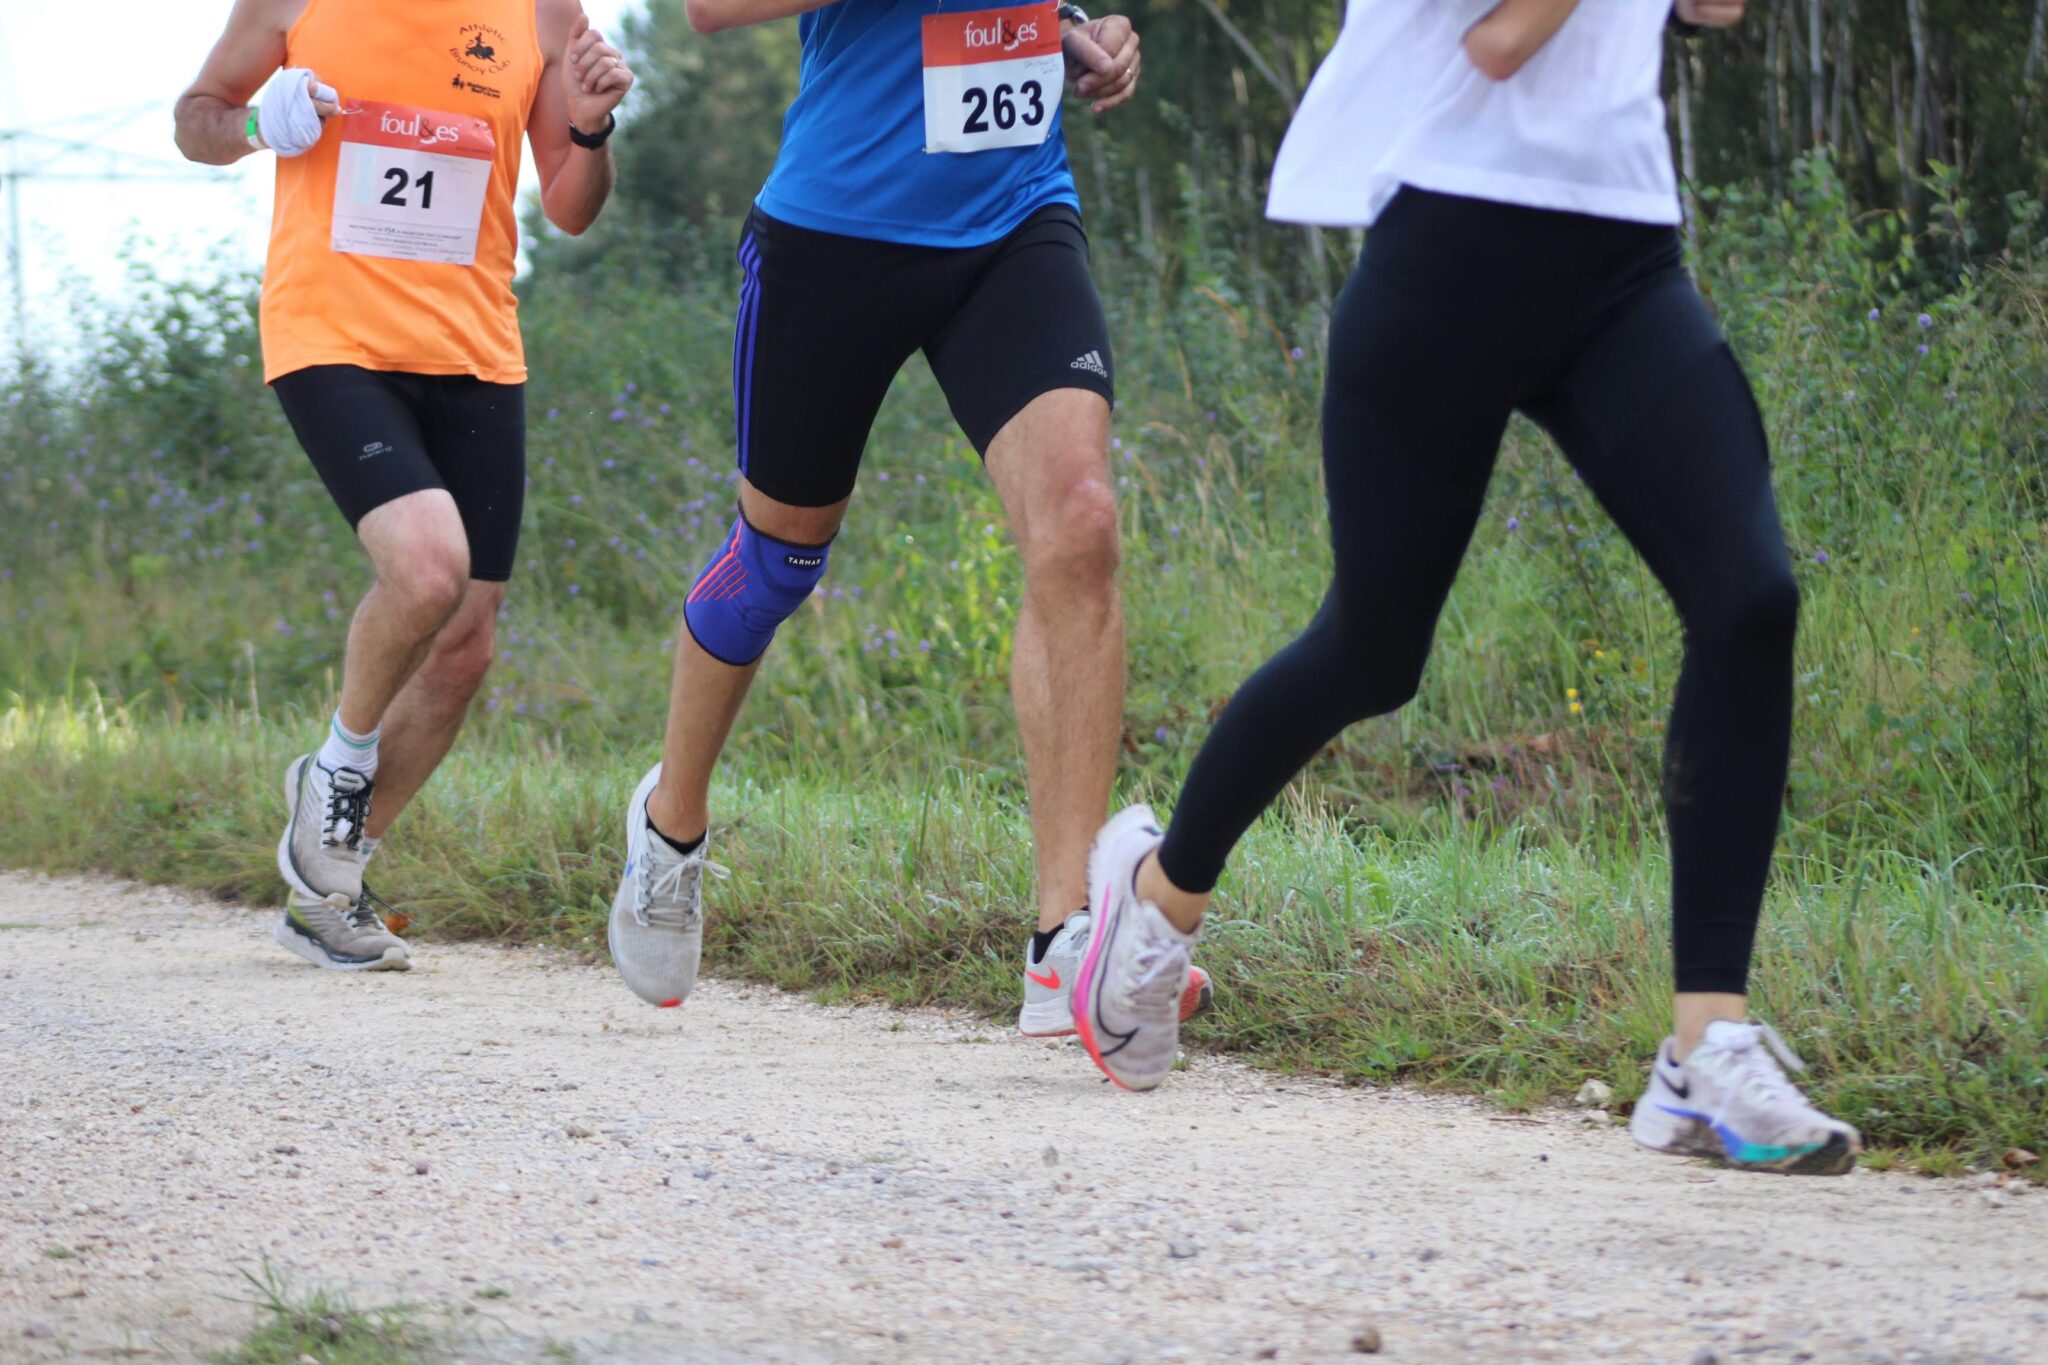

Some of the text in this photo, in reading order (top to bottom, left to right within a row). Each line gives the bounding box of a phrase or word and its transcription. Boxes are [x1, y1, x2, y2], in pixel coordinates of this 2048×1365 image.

[459, 24, 508, 45] Athletic
[449, 47, 511, 75] Brunoy Club
[961, 80, 1045, 134] 263
[380, 167, 434, 209] 21
[1070, 361, 1107, 378] adidas
[788, 556, 822, 566] TARMAK
